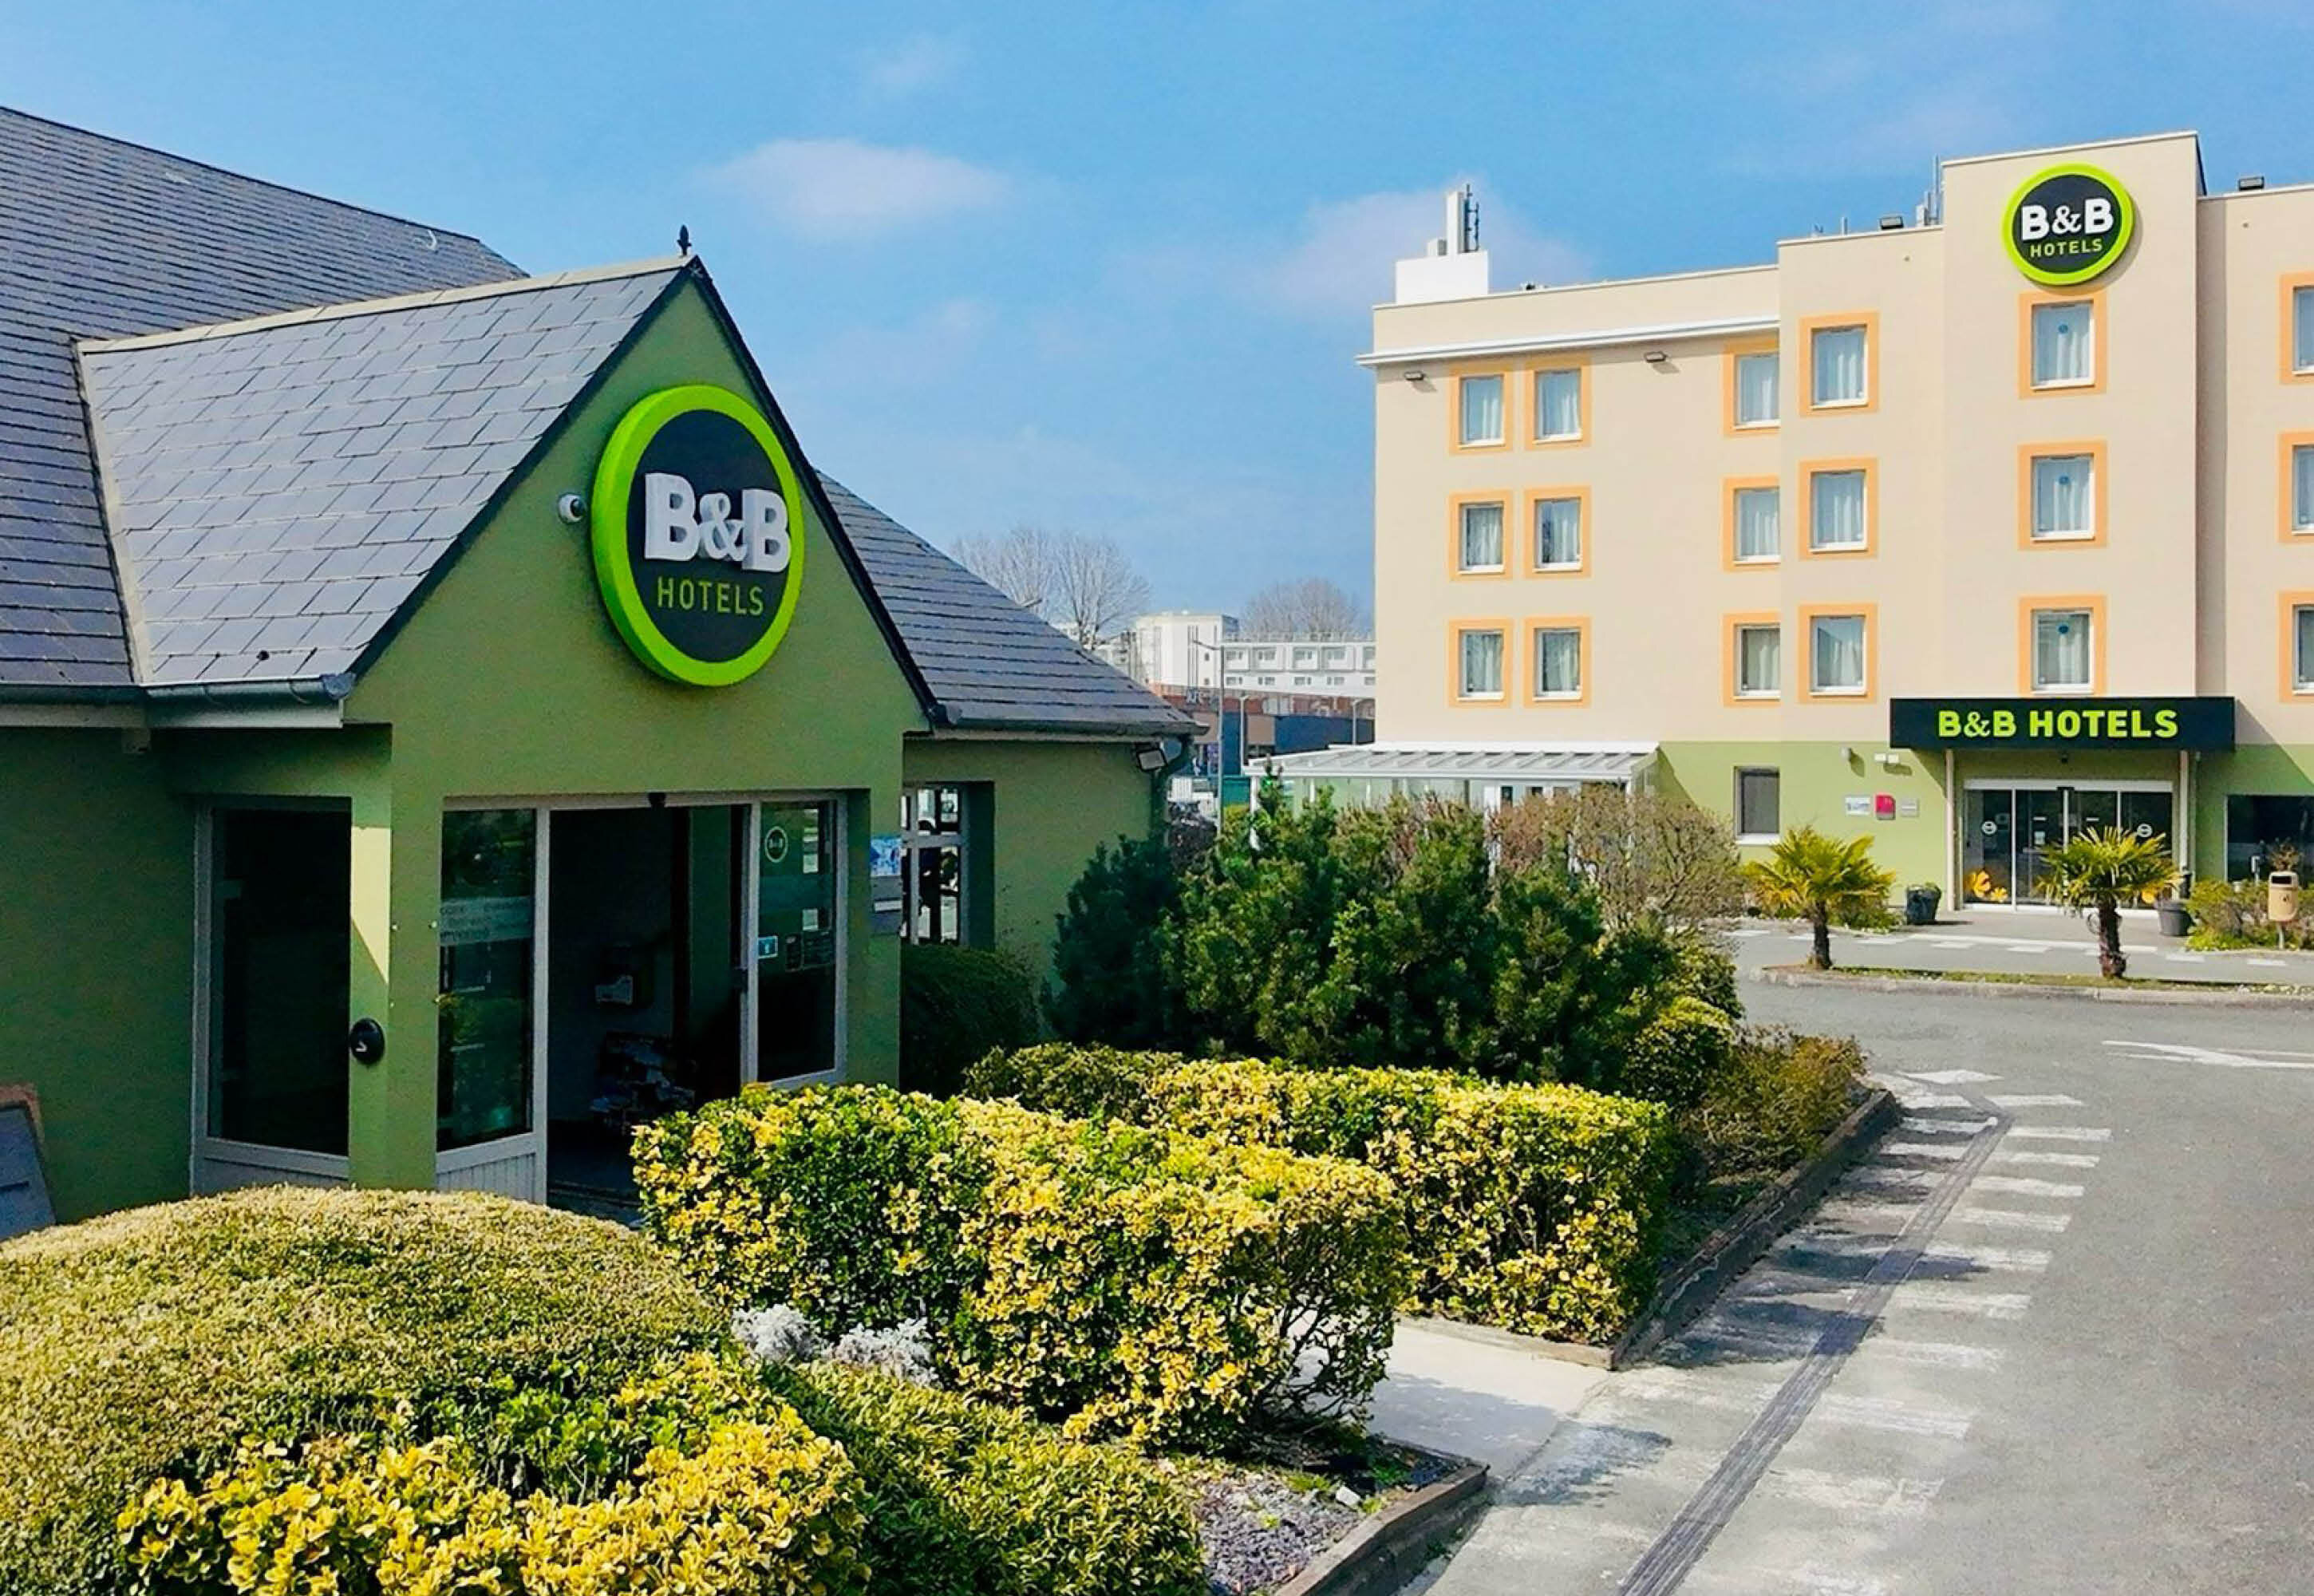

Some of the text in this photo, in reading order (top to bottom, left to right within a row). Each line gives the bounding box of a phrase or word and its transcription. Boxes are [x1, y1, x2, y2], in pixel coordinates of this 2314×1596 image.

[2021, 198, 2114, 240] B&B
[2030, 239, 2103, 257] HOTELS
[645, 472, 791, 573] B&B
[657, 575, 764, 616] HOTELS
[1938, 709, 2178, 738] B&B HOTELS
